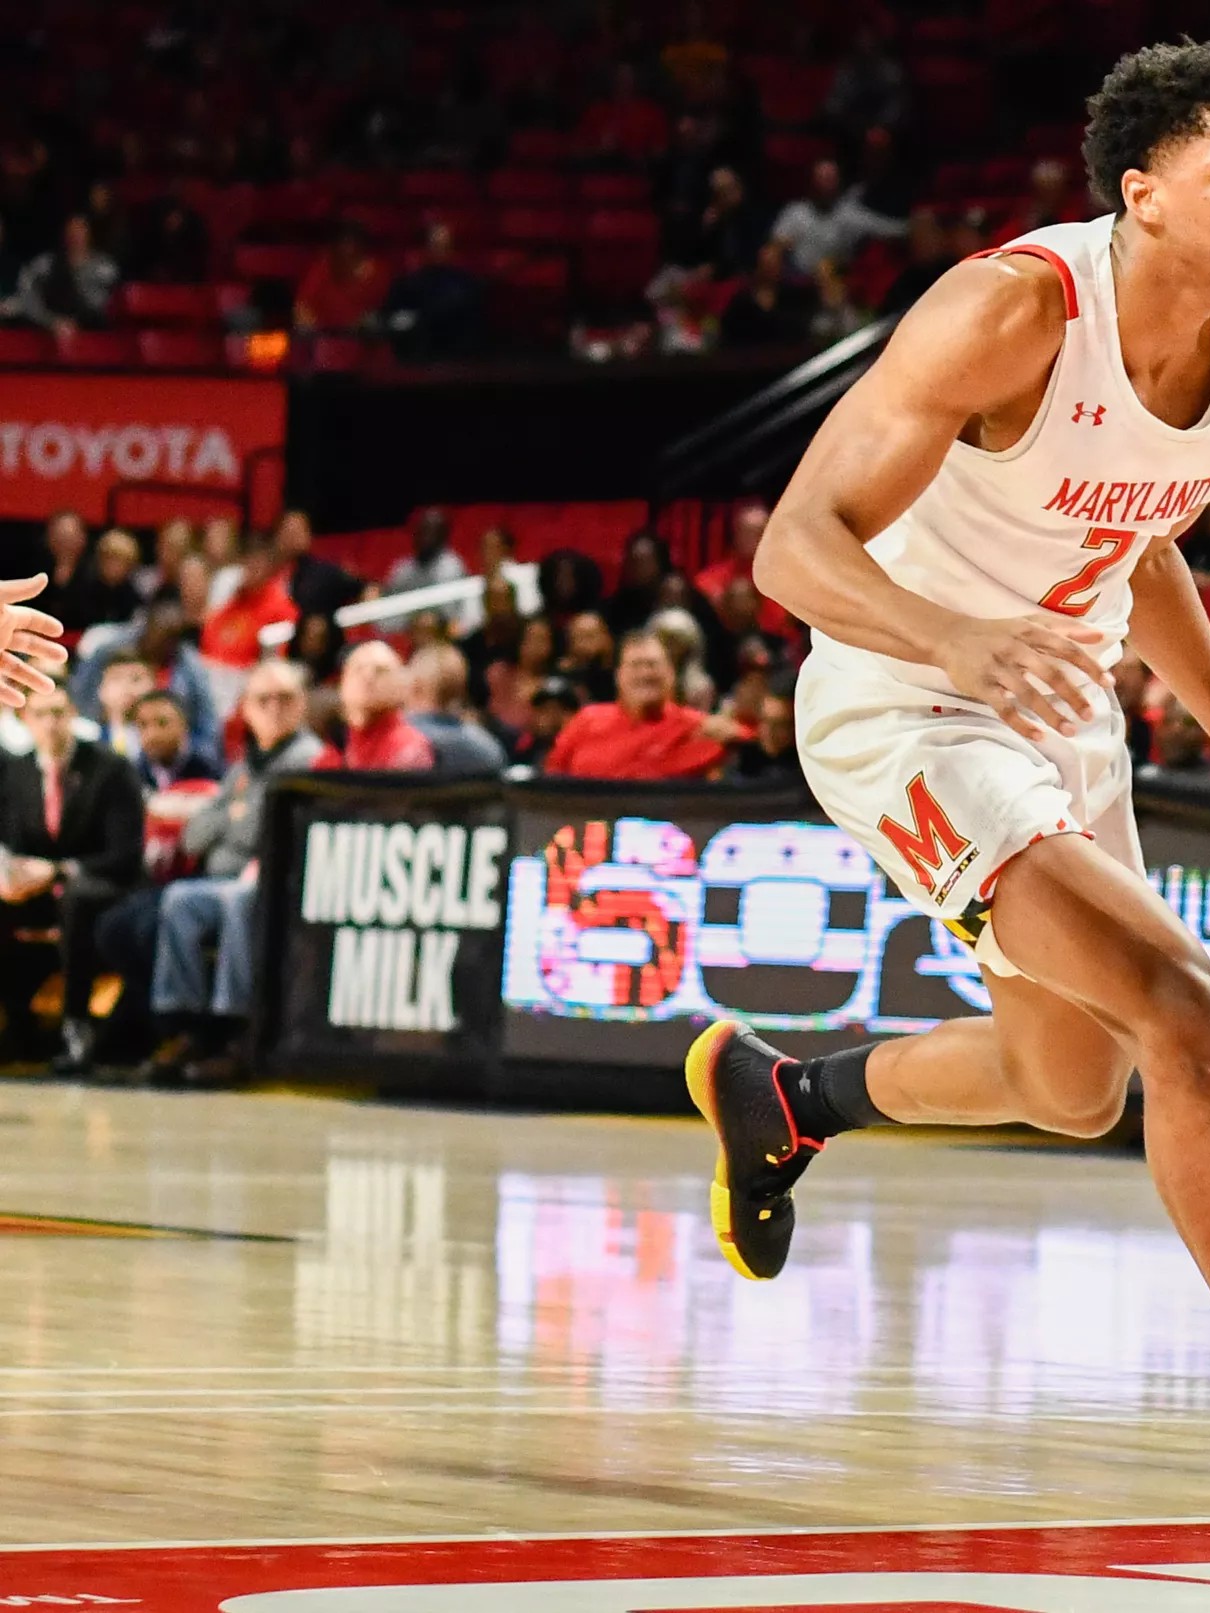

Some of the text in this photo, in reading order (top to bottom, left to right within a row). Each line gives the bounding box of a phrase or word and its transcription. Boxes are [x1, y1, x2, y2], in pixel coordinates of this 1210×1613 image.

[0, 421, 241, 485] TOYOTA
[1038, 527, 1138, 617] 2
[302, 821, 508, 930] MUSCLE
[877, 770, 973, 896] M
[327, 926, 461, 1032] MILK
